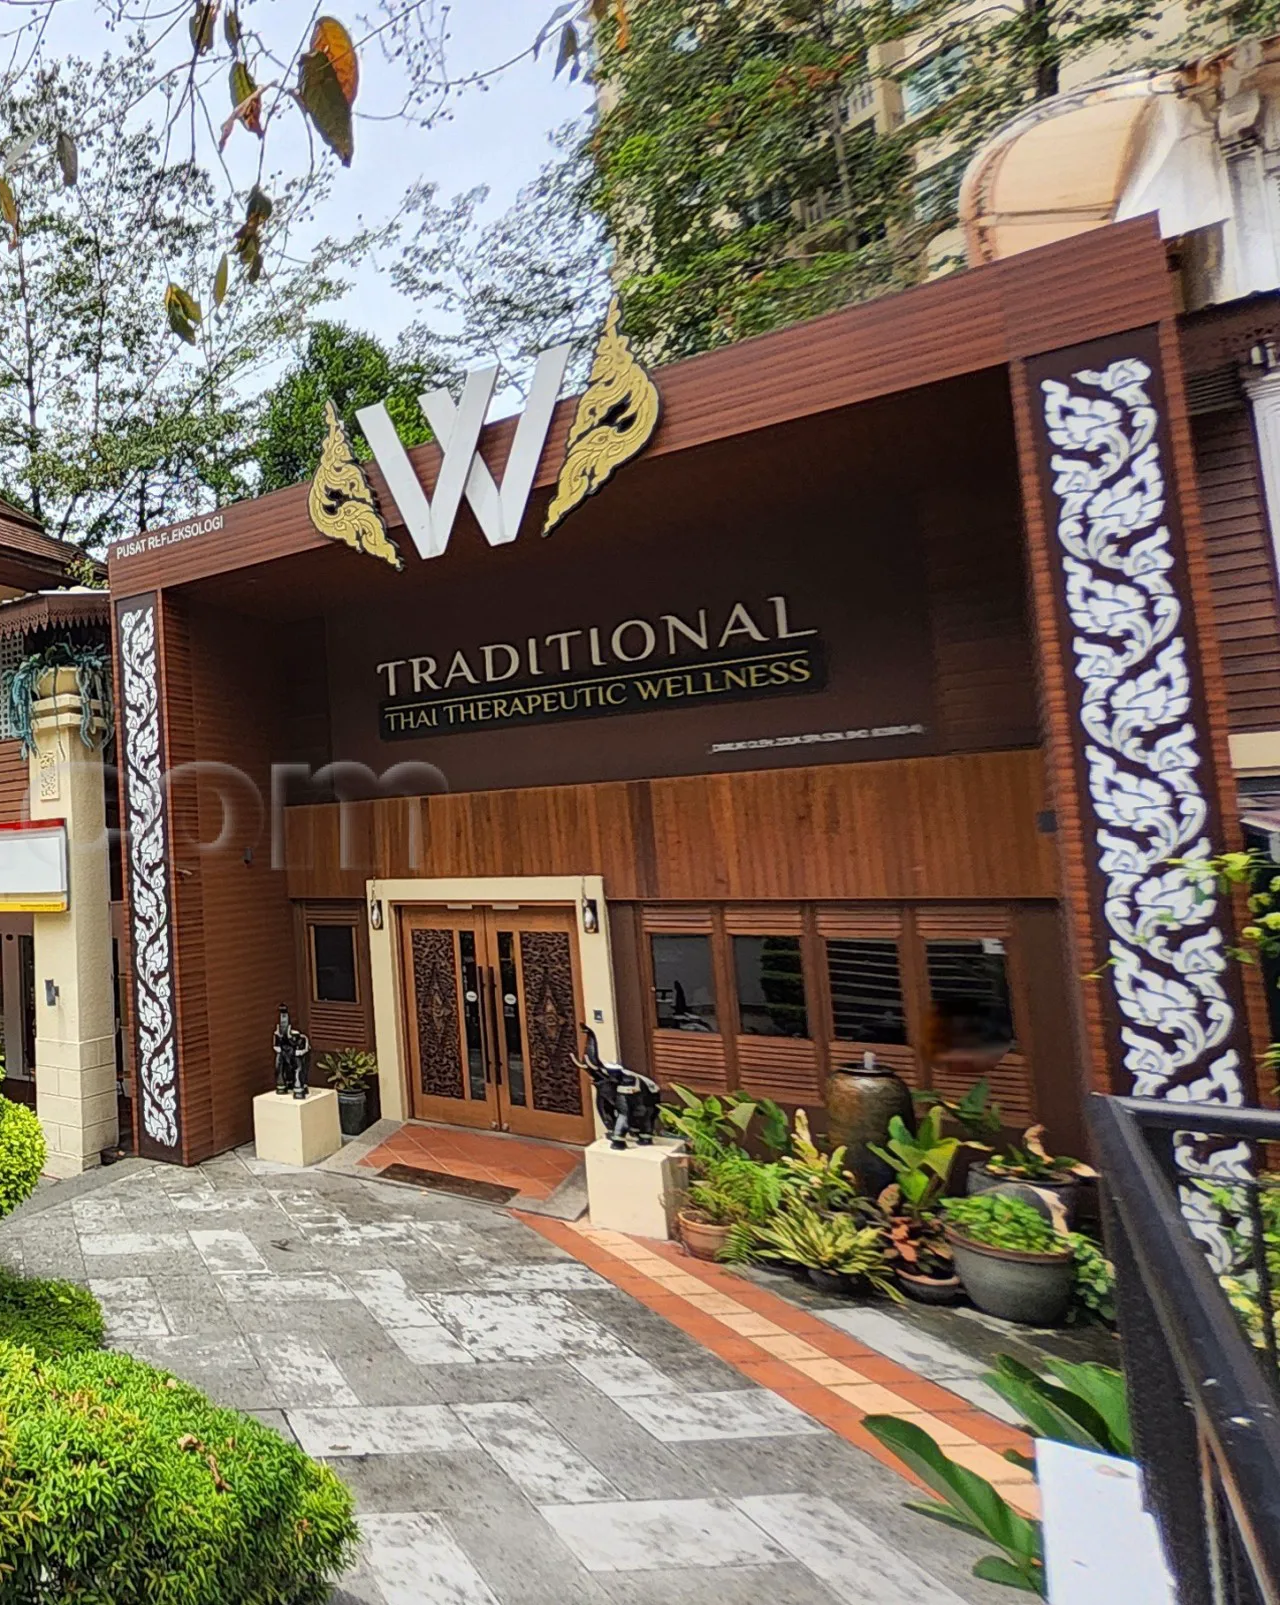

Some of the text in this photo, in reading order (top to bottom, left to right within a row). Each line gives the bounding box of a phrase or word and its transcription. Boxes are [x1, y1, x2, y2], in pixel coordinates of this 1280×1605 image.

[354, 342, 571, 560] W
[116, 515, 224, 560] PUSAT REFLEKSOLOGI
[376, 596, 818, 697] TRADITIONAL
[384, 658, 812, 732] THAI THERAPEUTIC WELLNESS
